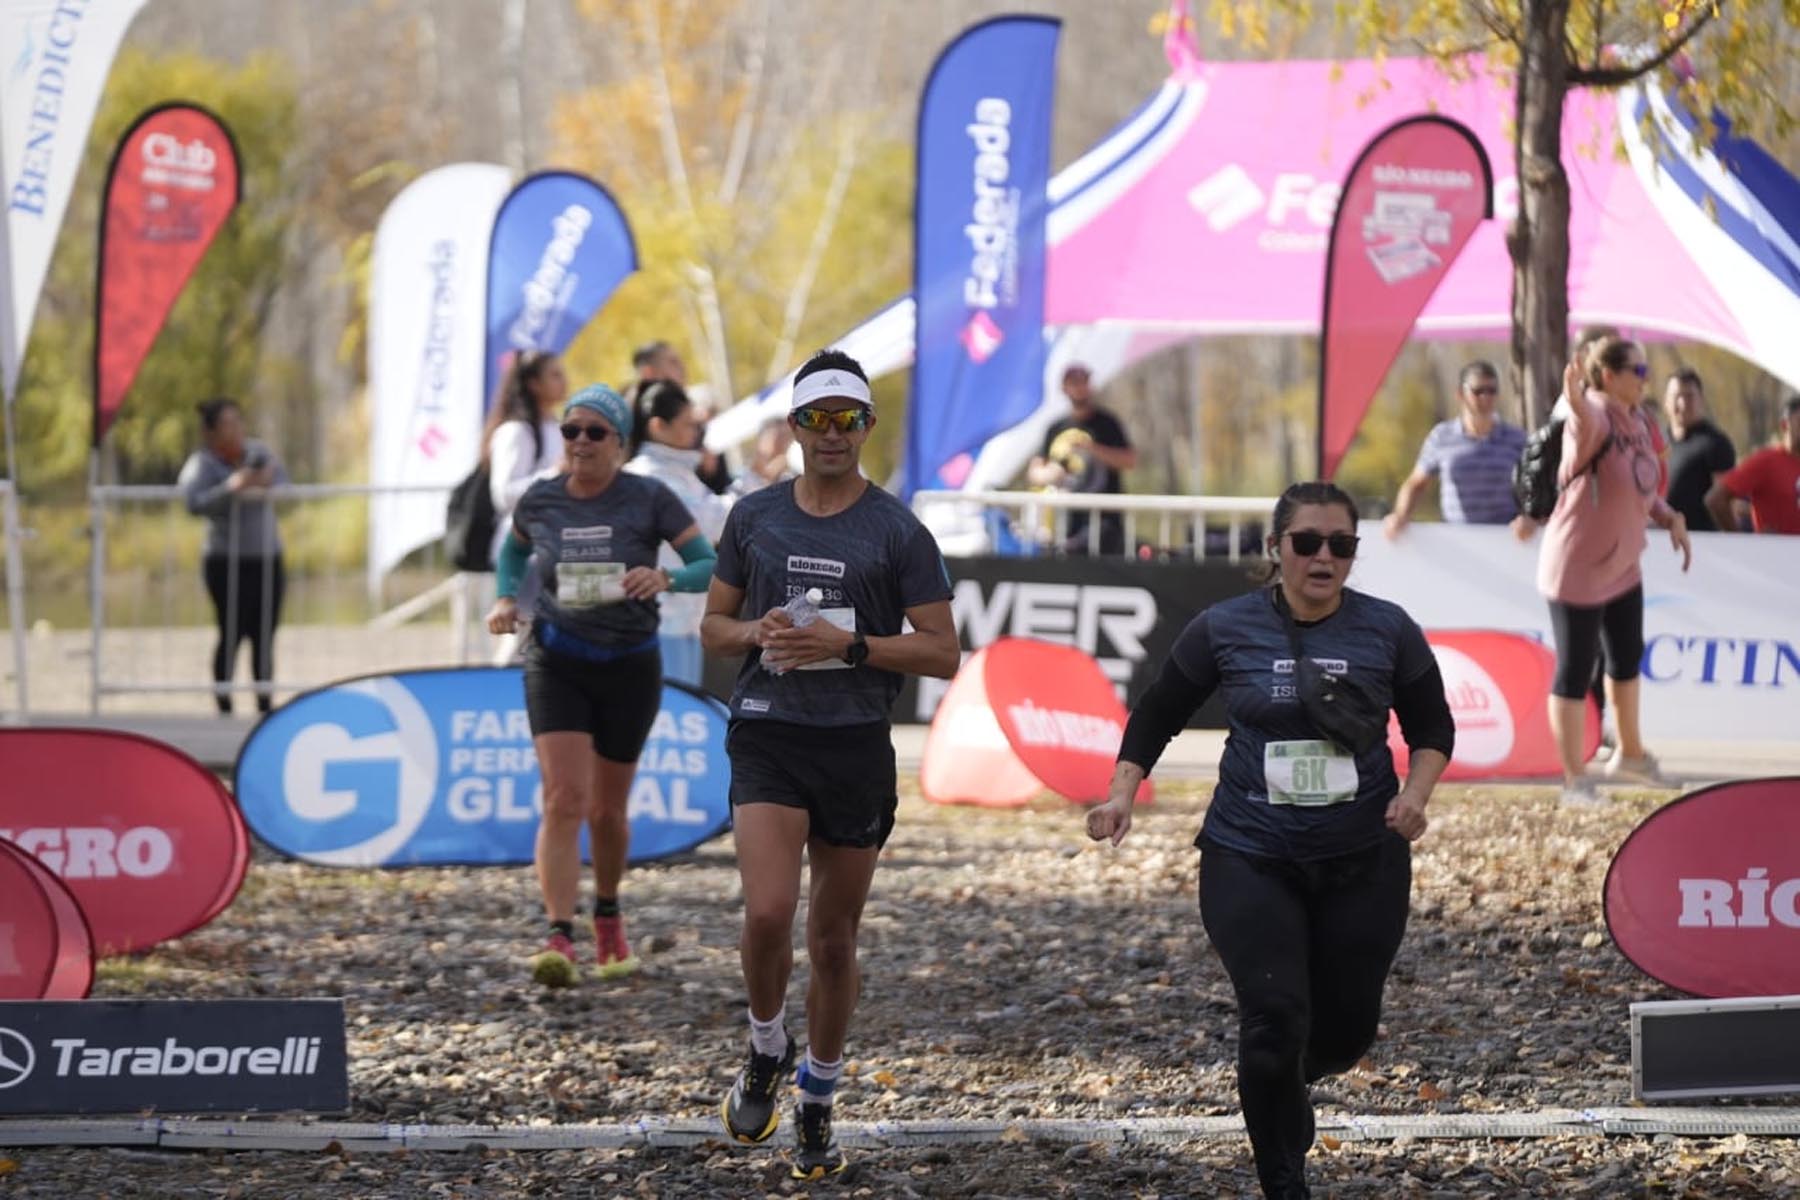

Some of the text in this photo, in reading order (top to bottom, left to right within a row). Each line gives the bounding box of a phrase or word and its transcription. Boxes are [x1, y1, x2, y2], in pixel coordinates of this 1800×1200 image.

[142, 133, 216, 172] Club
[963, 98, 1011, 307] Federada
[509, 203, 593, 348] Federada
[416, 238, 457, 414] Federada
[950, 578, 1157, 660] WER
[451, 710, 708, 742] FARAS
[1292, 758, 1328, 791] 6K
[447, 777, 708, 822] GLAL
[0, 826, 173, 878] GRO
[51, 1037, 321, 1077] Taraborelli
